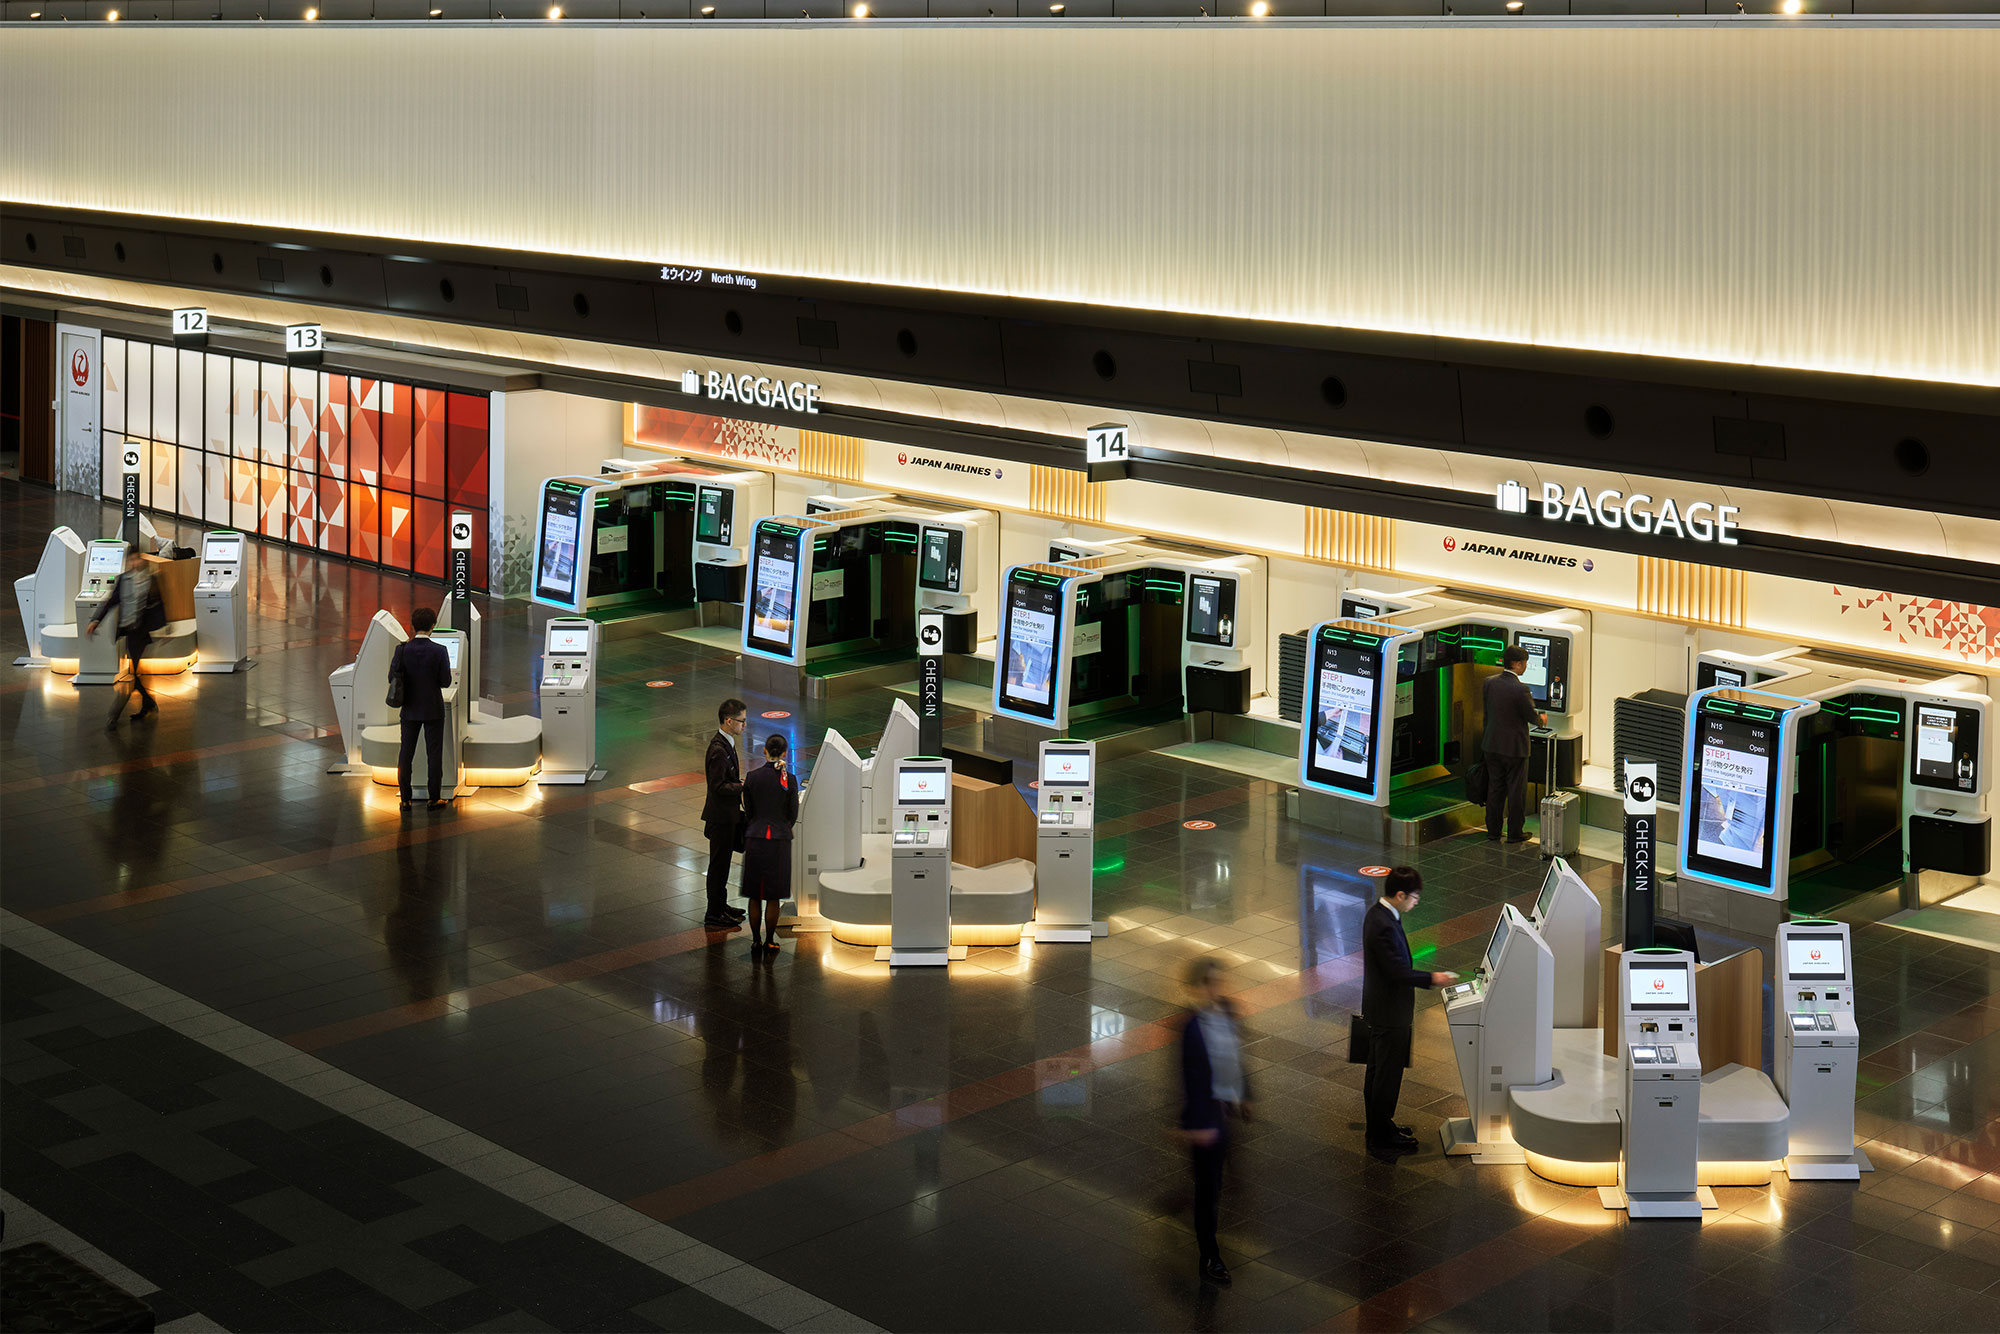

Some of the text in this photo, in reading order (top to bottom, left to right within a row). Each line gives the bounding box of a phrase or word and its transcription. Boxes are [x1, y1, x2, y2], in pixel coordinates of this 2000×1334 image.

[660, 266, 703, 283] 北ウイング
[711, 272, 757, 289] North Wing
[180, 312, 203, 331] 12
[293, 329, 317, 348] 13
[708, 370, 819, 414] BAGGAGE
[1096, 431, 1126, 458] 14
[910, 457, 992, 476] JAPAN AIRLINES
[126, 475, 135, 517] CHECK-IN
[1542, 482, 1740, 545] BAGGAGE
[1461, 542, 1578, 568] JAPAN AIRLINES
[456, 551, 465, 600] CHECK-IN
[1322, 671, 1343, 683] STEP.1
[925, 659, 937, 717] CHECK-IN
[1710, 722, 1723, 731] N15
[1752, 730, 1765, 738] N16
[1708, 736, 1724, 745] Open
[1749, 744, 1766, 753] Open
[1705, 748, 1730, 760] STEP.1
[1635, 819, 1649, 891] CHECK-IN
